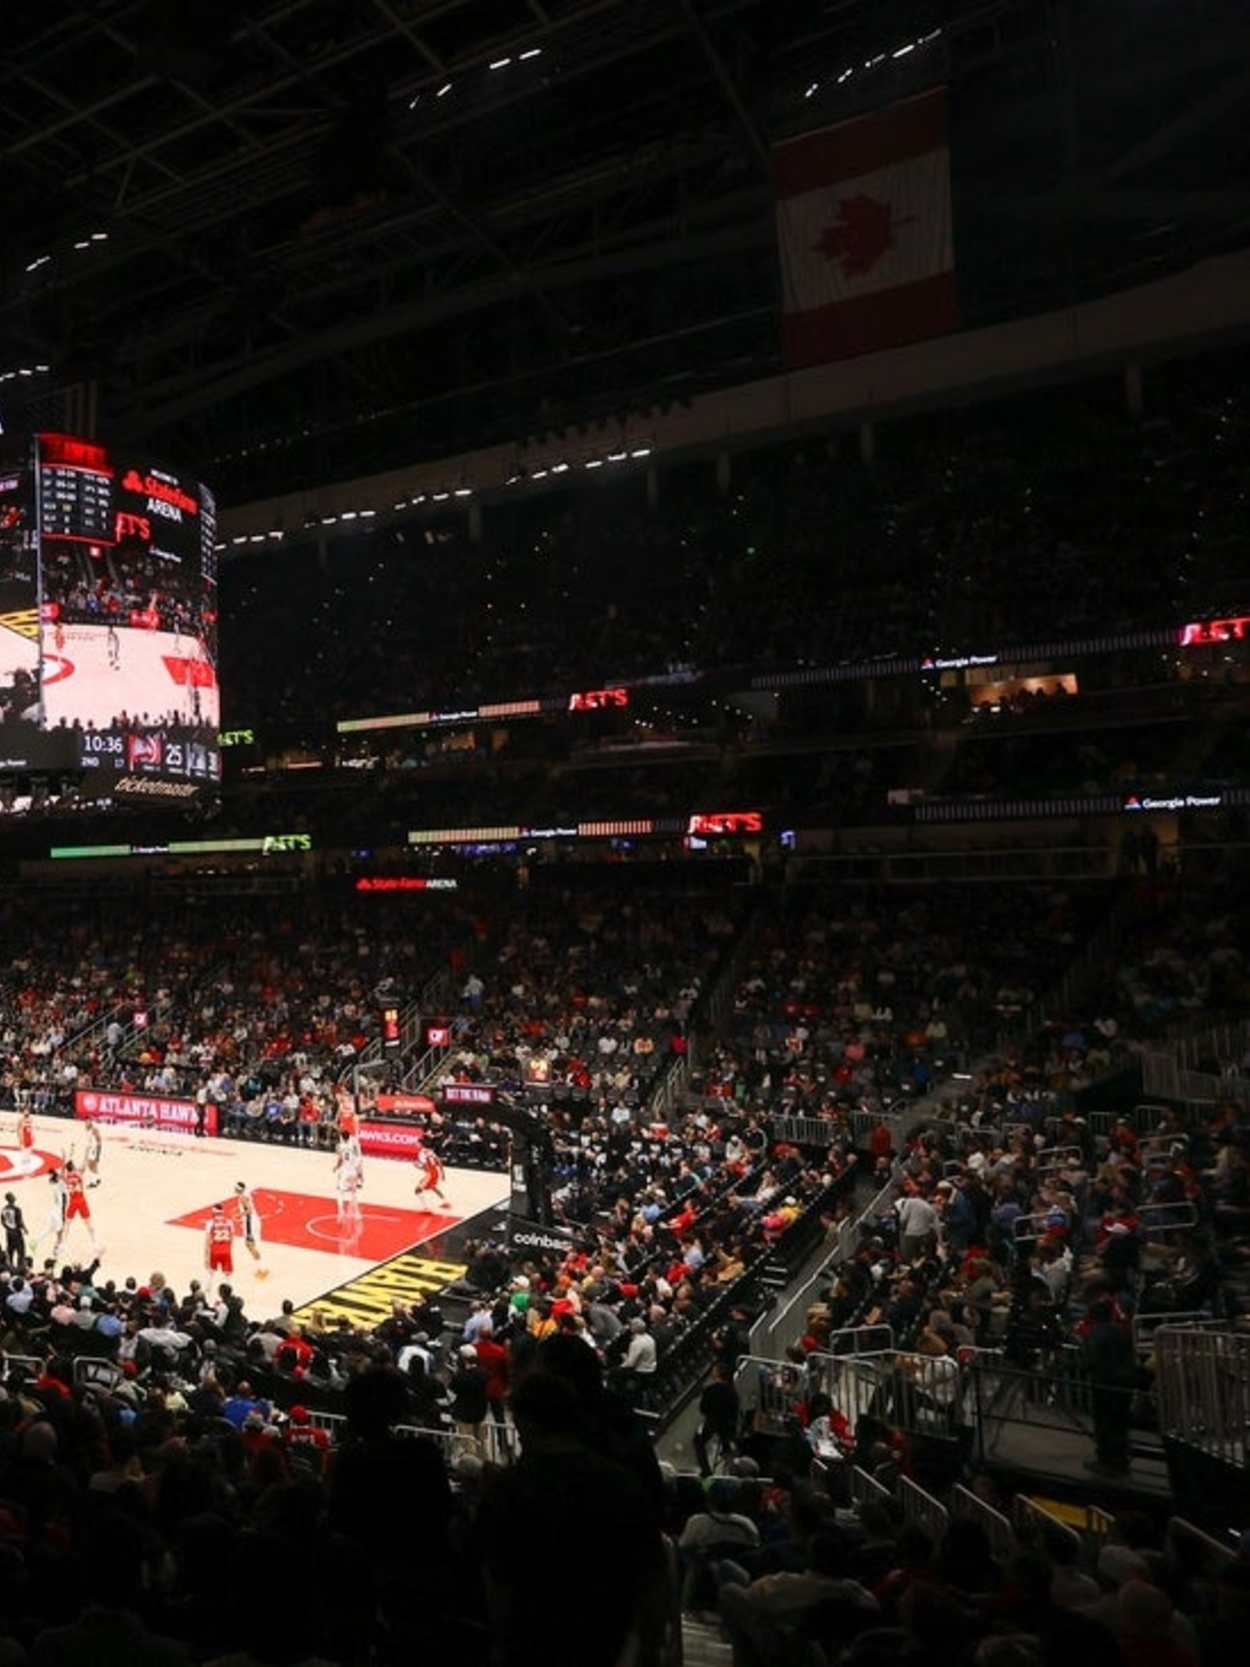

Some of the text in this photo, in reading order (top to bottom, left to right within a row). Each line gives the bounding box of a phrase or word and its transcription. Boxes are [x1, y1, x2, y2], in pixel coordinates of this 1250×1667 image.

[84, 736, 123, 753] 10:36
[166, 743, 182, 766] 25
[426, 879, 457, 889] ARENA
[100, 1094, 208, 1125] ATLANTA HAWK
[359, 1129, 419, 1145] AWKS.COM
[513, 1232, 564, 1251] coinba
